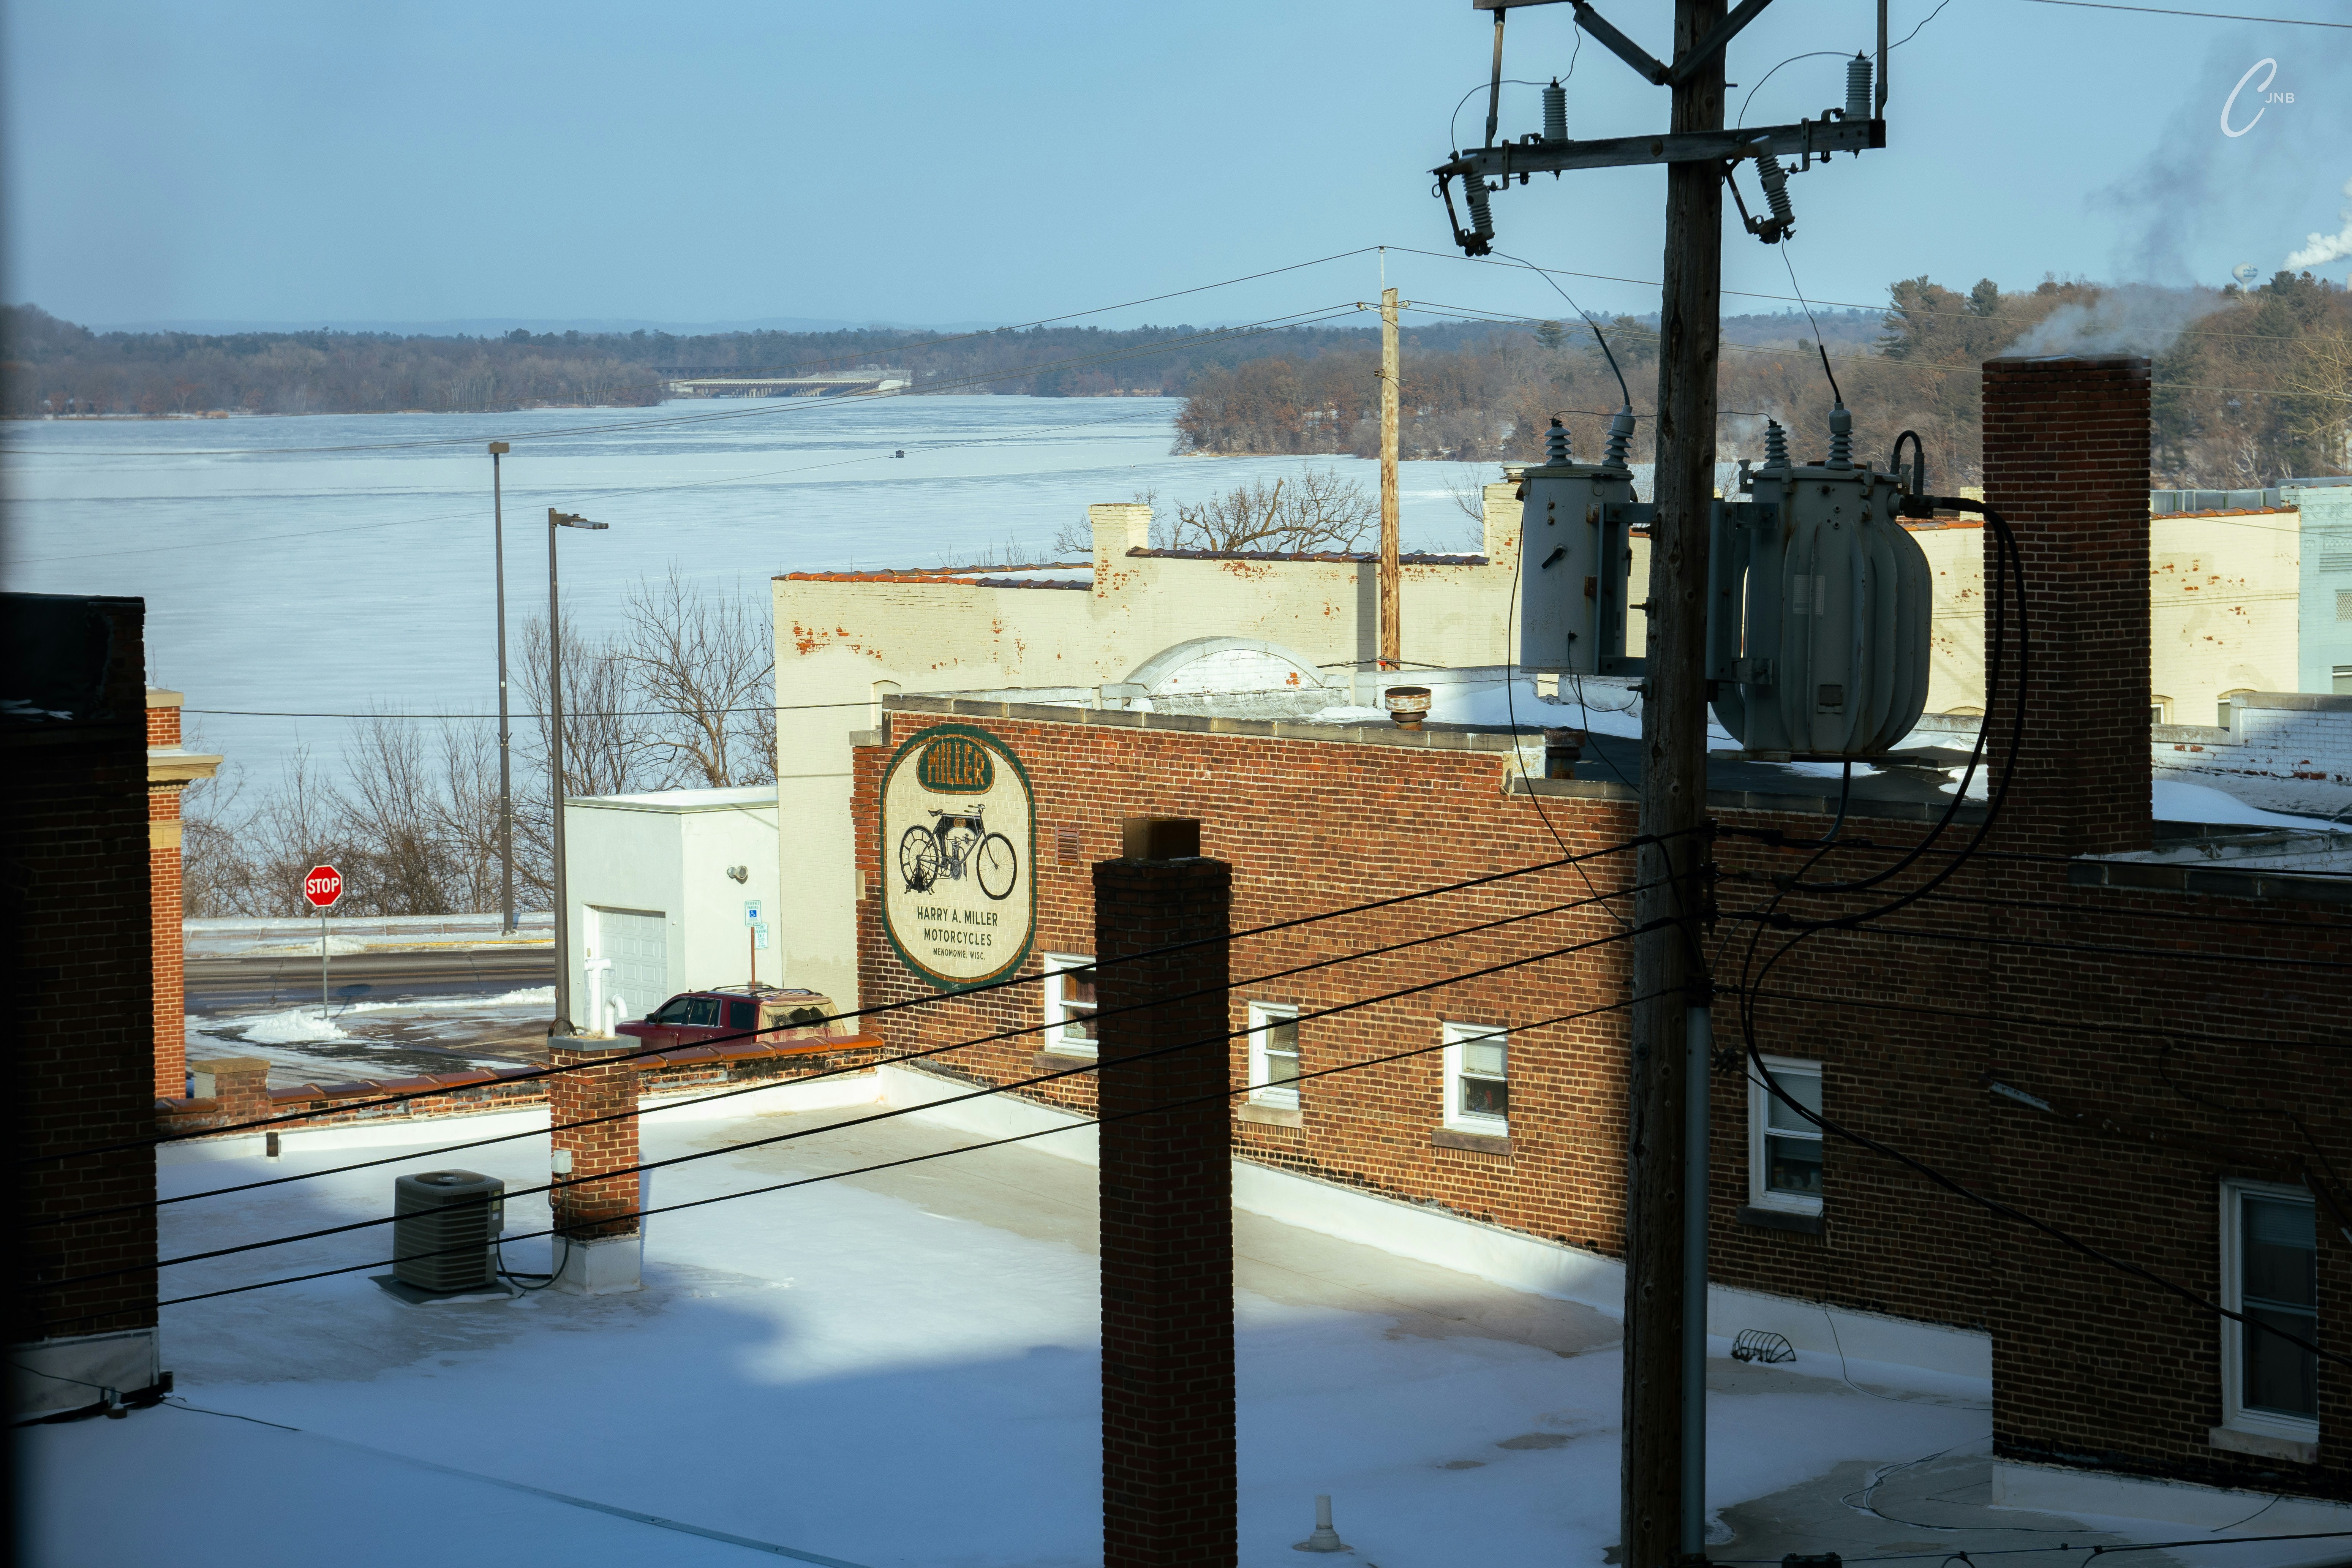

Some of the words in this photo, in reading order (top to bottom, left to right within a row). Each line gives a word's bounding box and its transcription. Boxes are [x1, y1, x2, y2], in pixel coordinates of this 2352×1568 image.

[928, 742, 986, 786] MILLER
[307, 877, 340, 894] STOP
[917, 906, 948, 922] HARRY
[952, 909, 961, 924] A.
[964, 910, 998, 926] MILLER
[924, 928, 991, 946] MOTORCYCLES
[969, 951, 985, 960] WISC.
